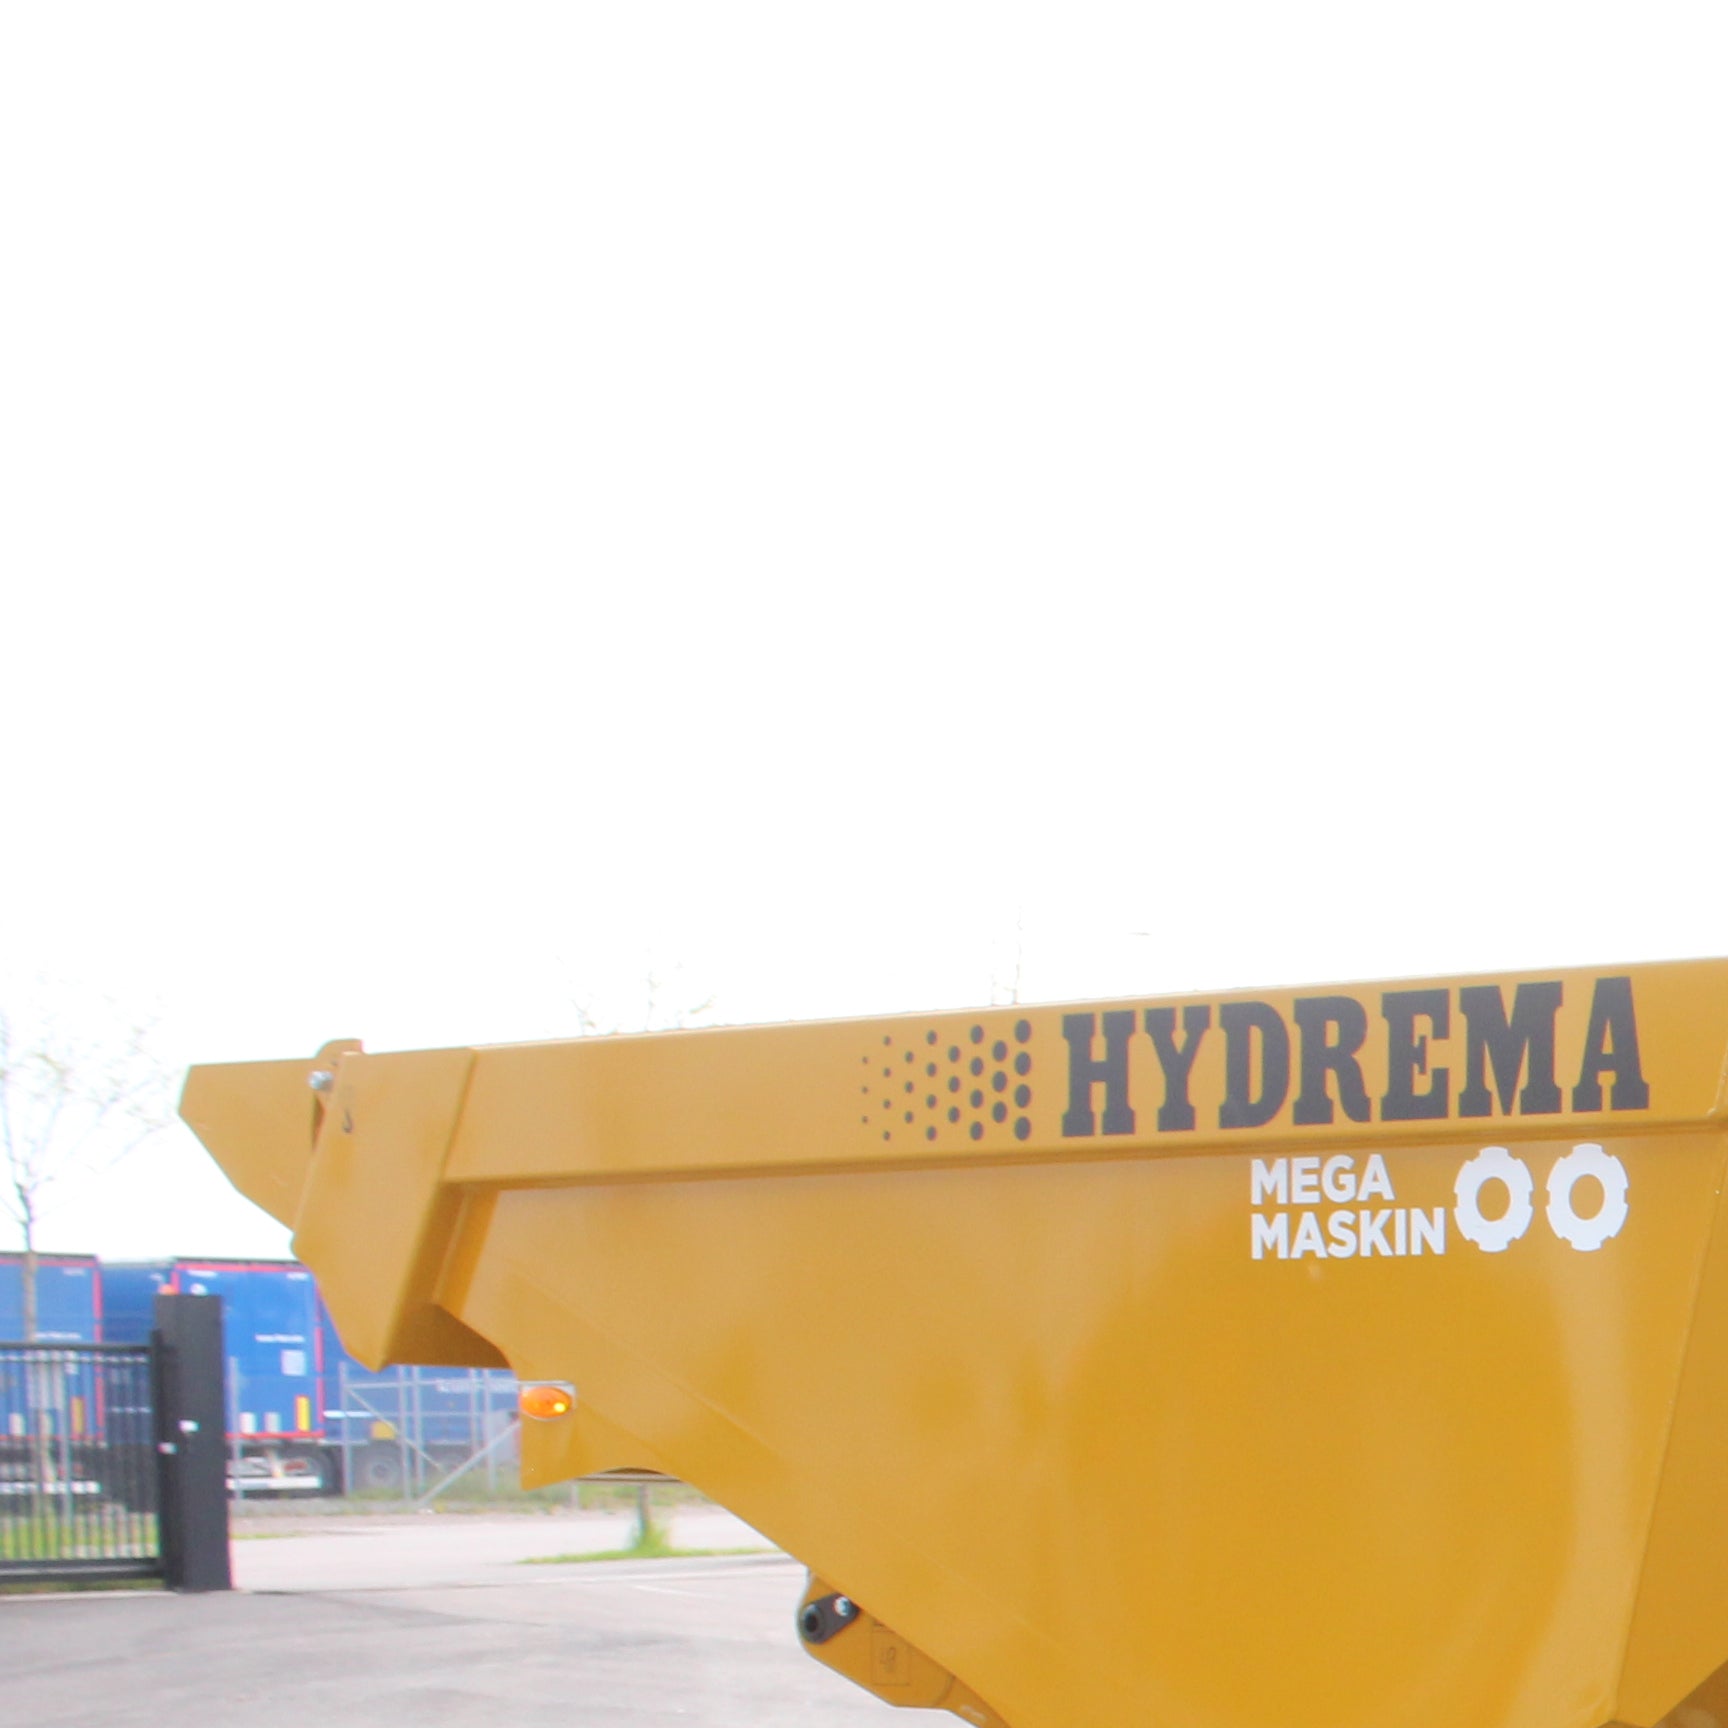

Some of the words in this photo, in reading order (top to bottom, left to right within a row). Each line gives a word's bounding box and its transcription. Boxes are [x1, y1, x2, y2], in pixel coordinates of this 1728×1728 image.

[1060, 976, 1650, 1138] HYDREMA
[1249, 1154, 1396, 1206] MEGA
[1250, 1205, 1446, 1260] MASKIN
